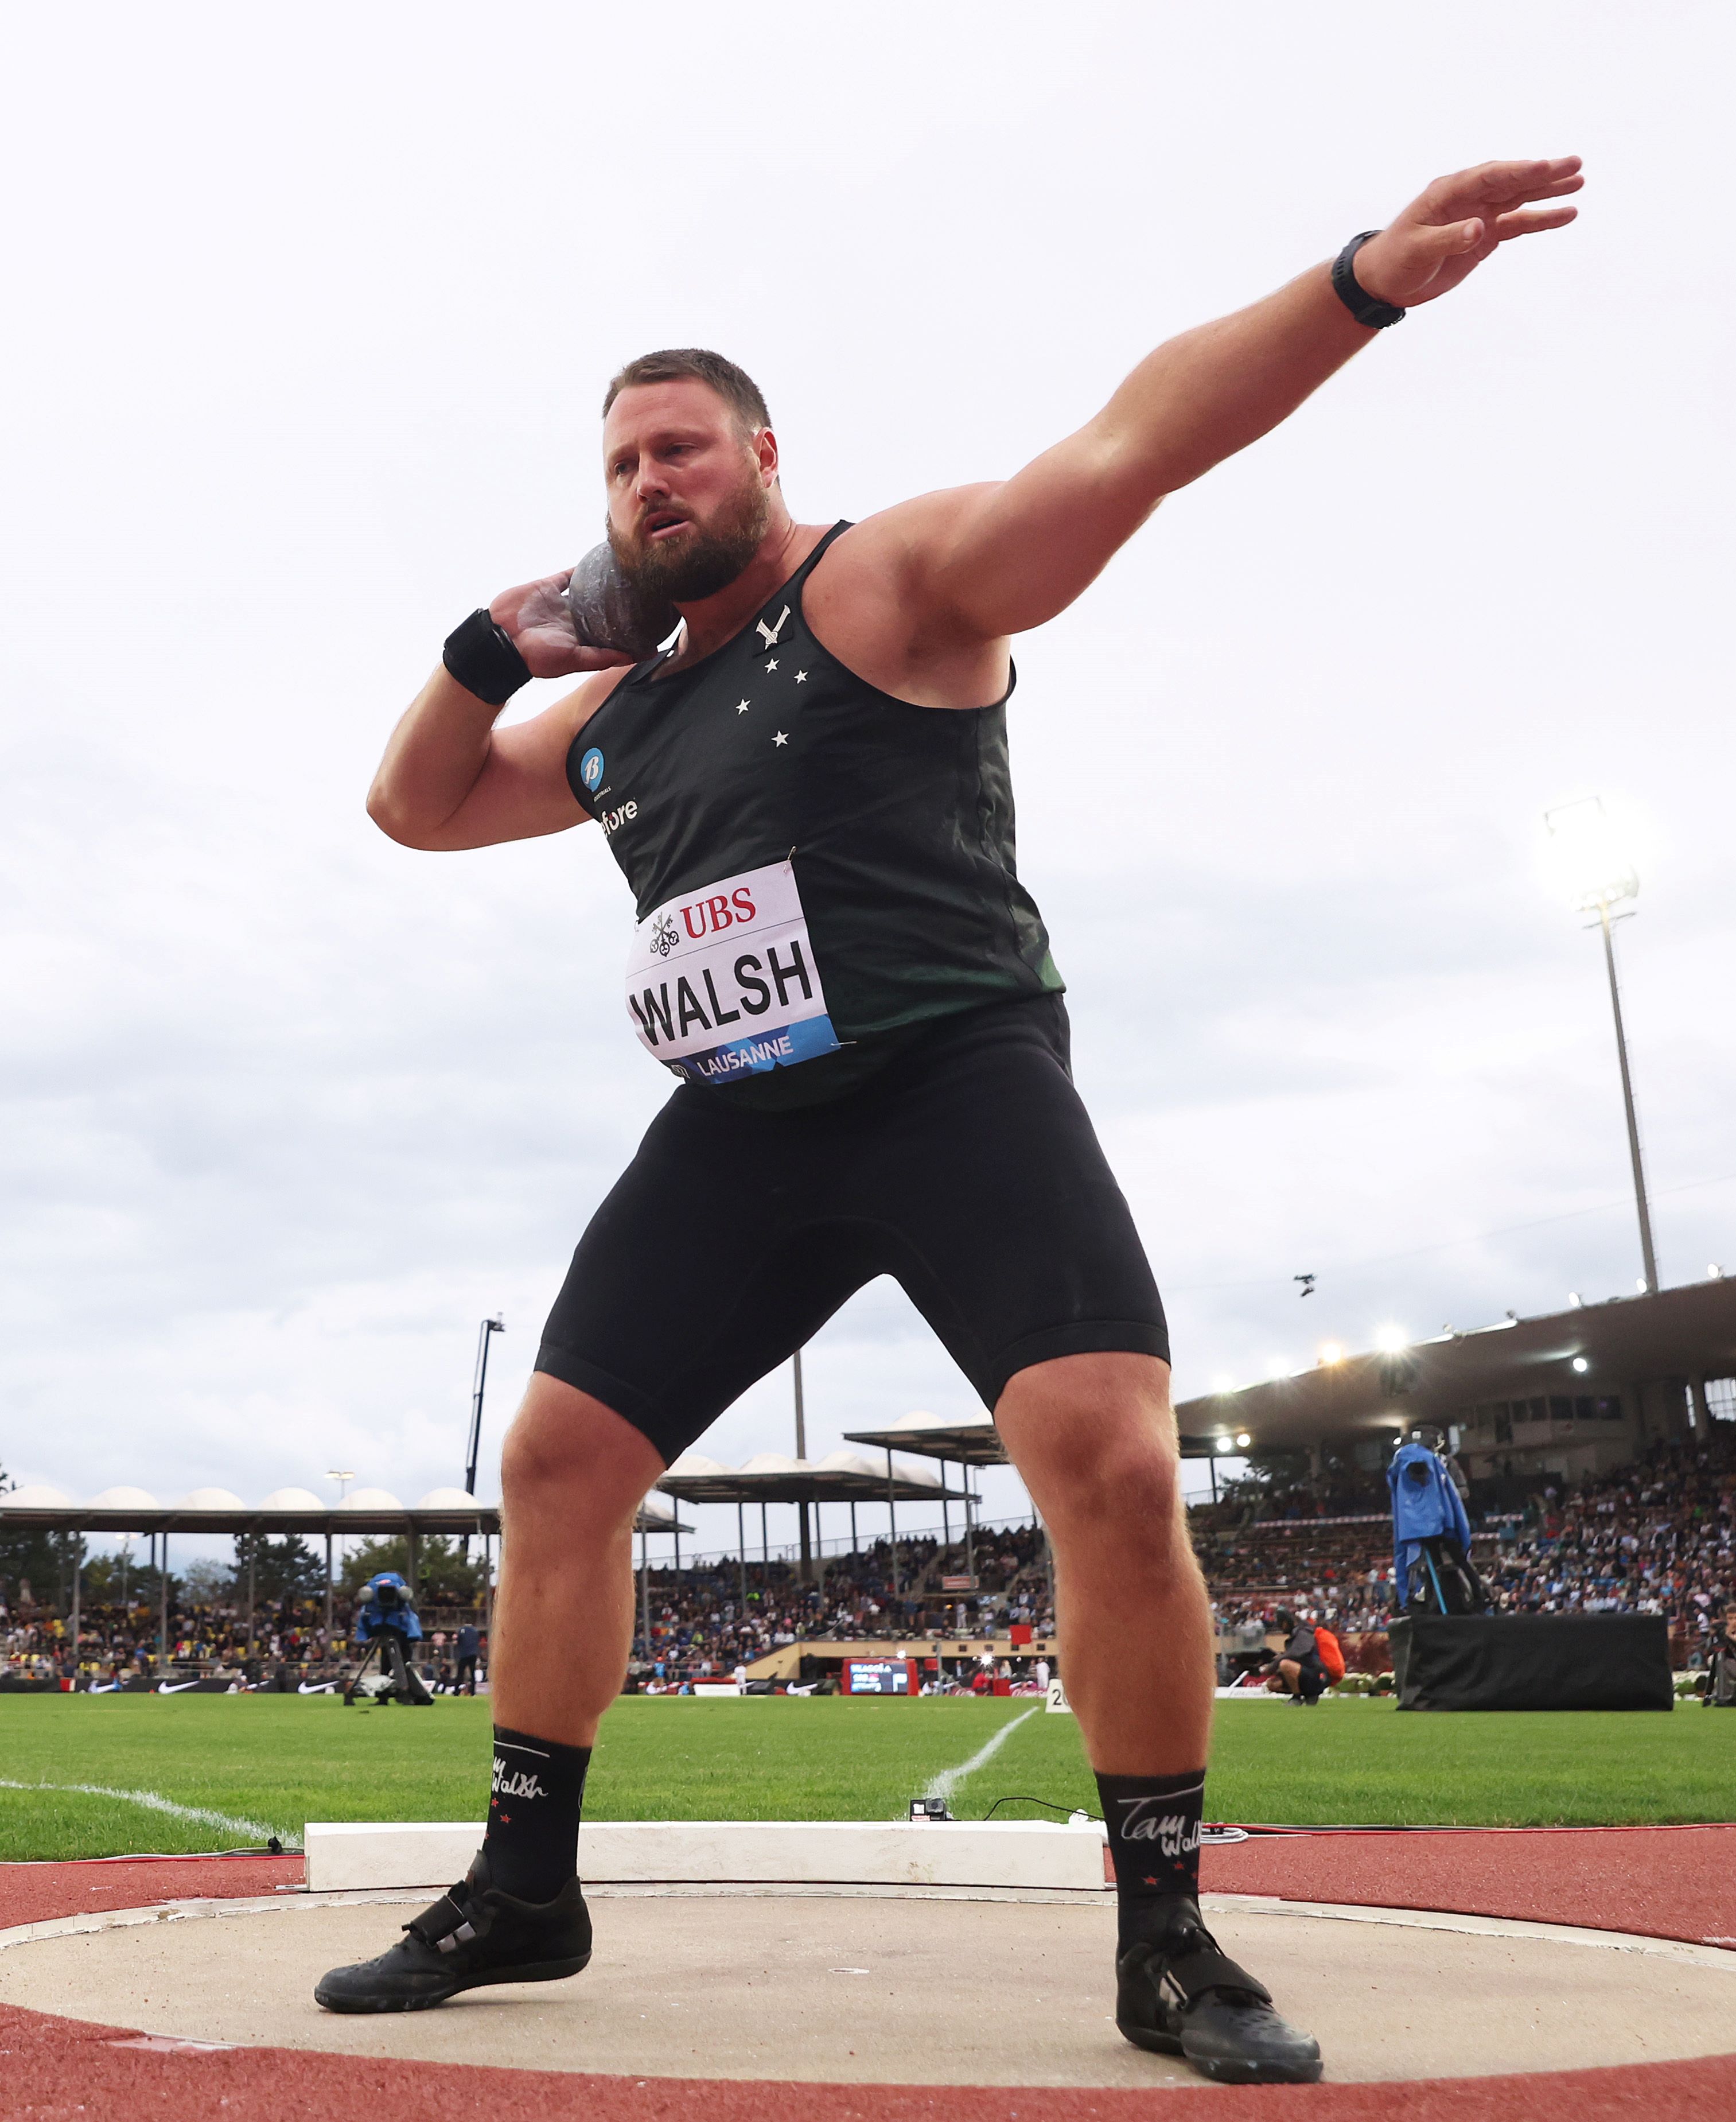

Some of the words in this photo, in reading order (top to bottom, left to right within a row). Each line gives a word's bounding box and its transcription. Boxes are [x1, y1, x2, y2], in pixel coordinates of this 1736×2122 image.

[679, 887, 756, 939] UBS
[629, 940, 813, 1046] WALSH
[697, 1035, 793, 1076] LAUSANNE
